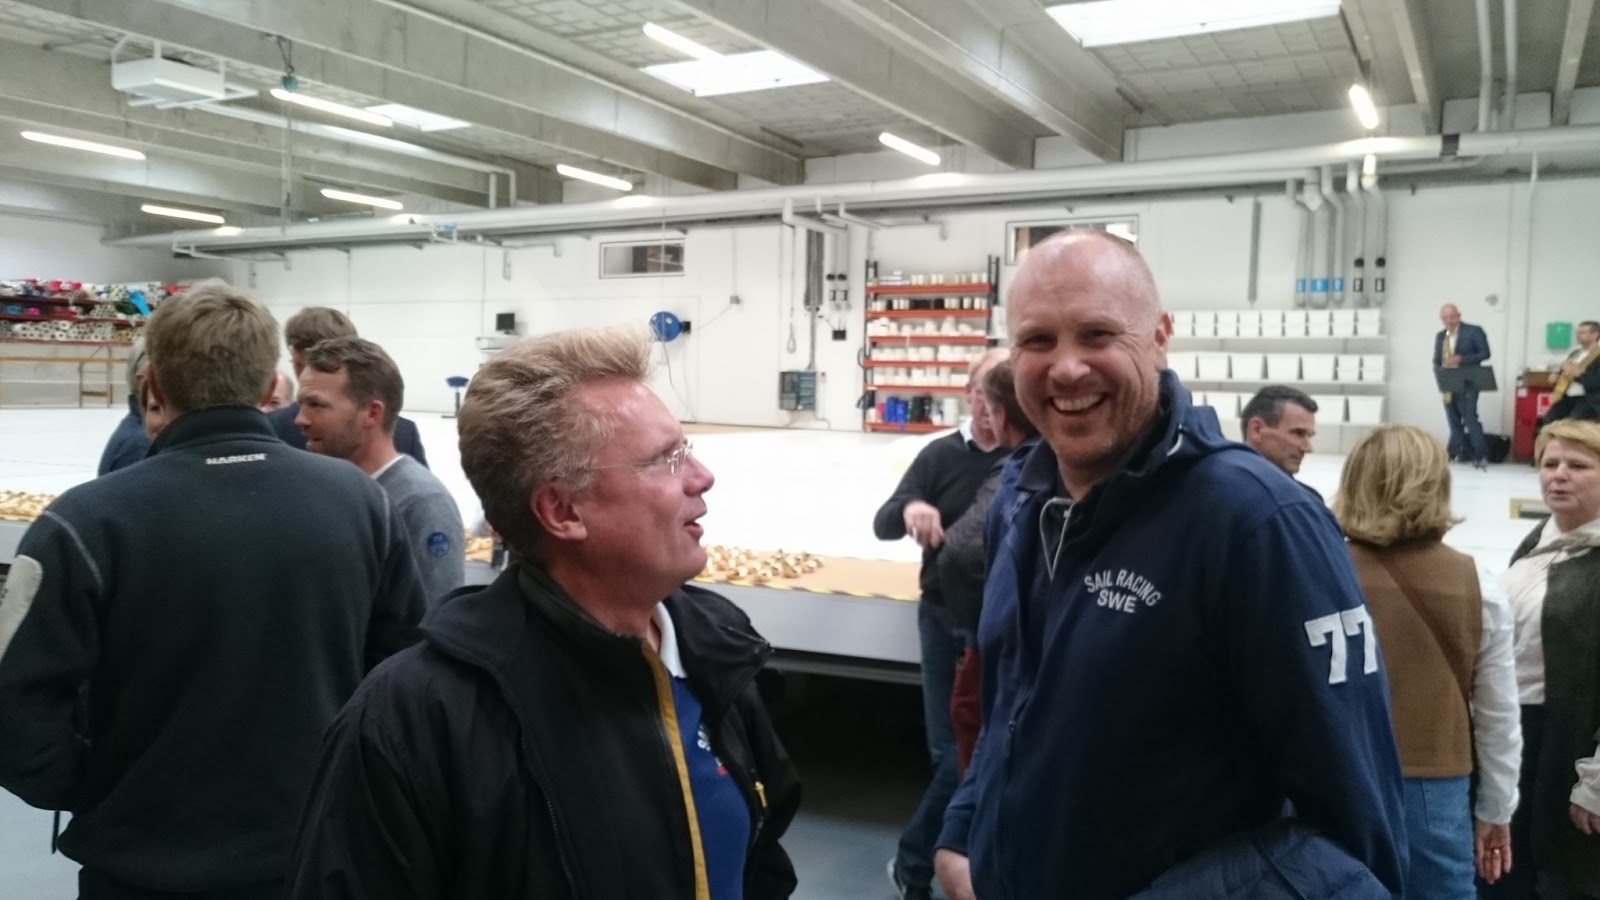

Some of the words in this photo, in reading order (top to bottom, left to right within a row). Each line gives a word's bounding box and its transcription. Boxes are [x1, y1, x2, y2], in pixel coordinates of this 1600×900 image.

[206, 453, 266, 464] HARKEN
[1084, 569, 1112, 593] SAIL
[1115, 568, 1161, 606] RACING
[1097, 588, 1137, 613] SWE
[1304, 603, 1378, 685] 77
